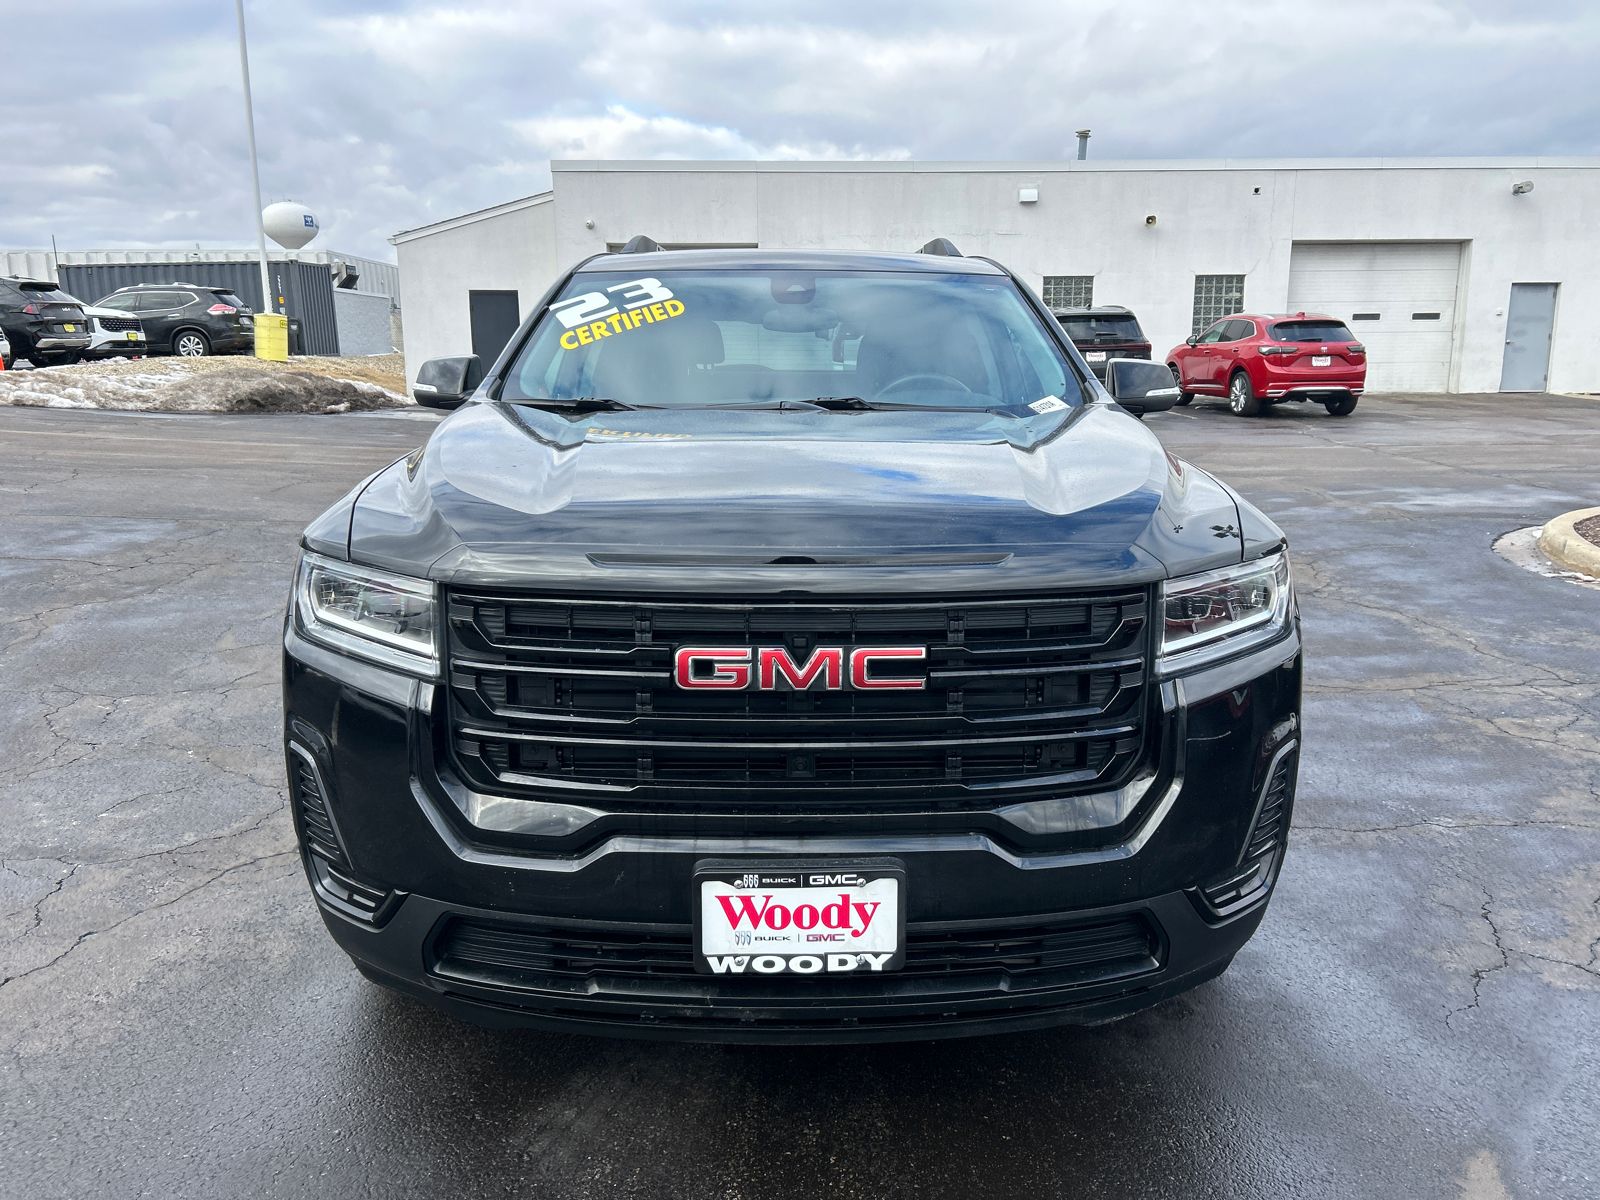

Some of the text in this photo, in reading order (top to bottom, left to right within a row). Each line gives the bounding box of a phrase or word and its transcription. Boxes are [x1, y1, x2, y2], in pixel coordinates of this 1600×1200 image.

[549, 277, 674, 329] 23
[559, 299, 685, 350] CERTIFIED
[674, 646, 927, 691] GMC
[809, 874, 858, 885] GMC
[715, 894, 881, 938] Woody
[806, 933, 845, 942] GMC
[706, 953, 893, 974] WOODY
